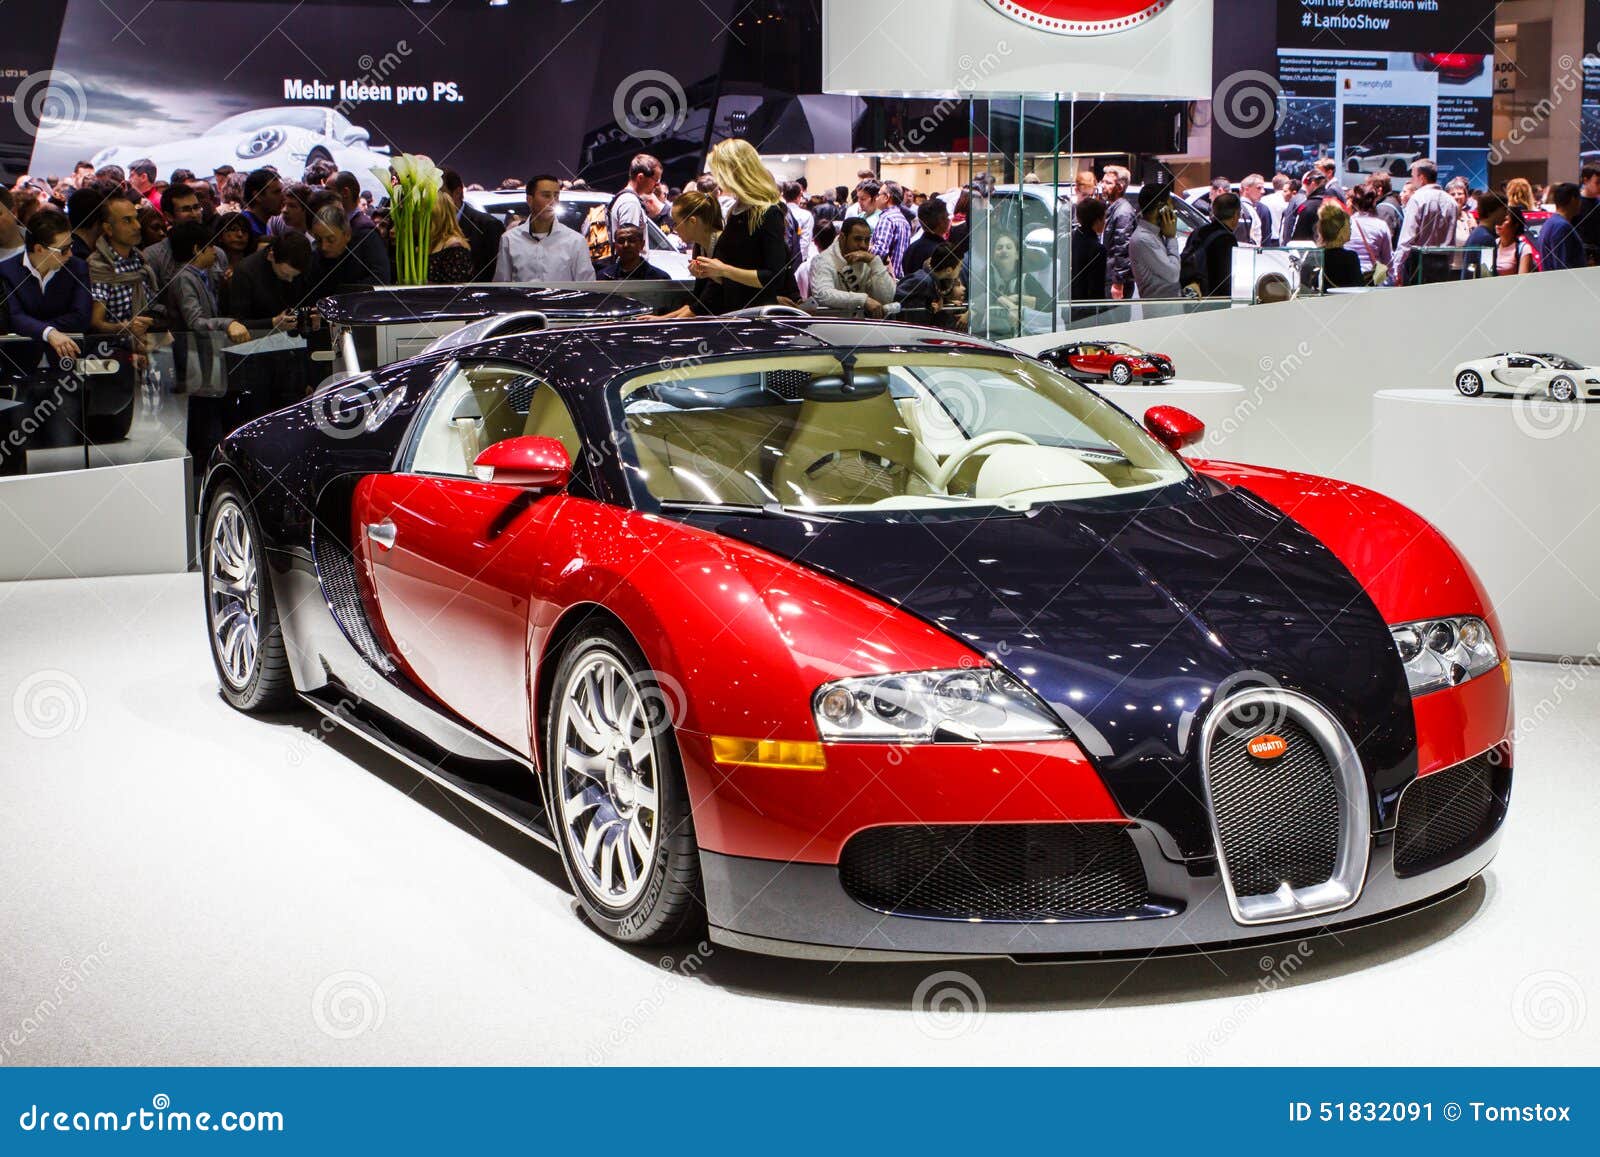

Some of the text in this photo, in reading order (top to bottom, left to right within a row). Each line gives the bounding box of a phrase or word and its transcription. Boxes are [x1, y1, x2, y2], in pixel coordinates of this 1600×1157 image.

[1347, 0, 1414, 11] Conversation
[1416, 0, 1439, 11] with
[284, 79, 464, 105] Mehr Ideen pro PS.
[1251, 740, 1284, 753] BUGATTI
